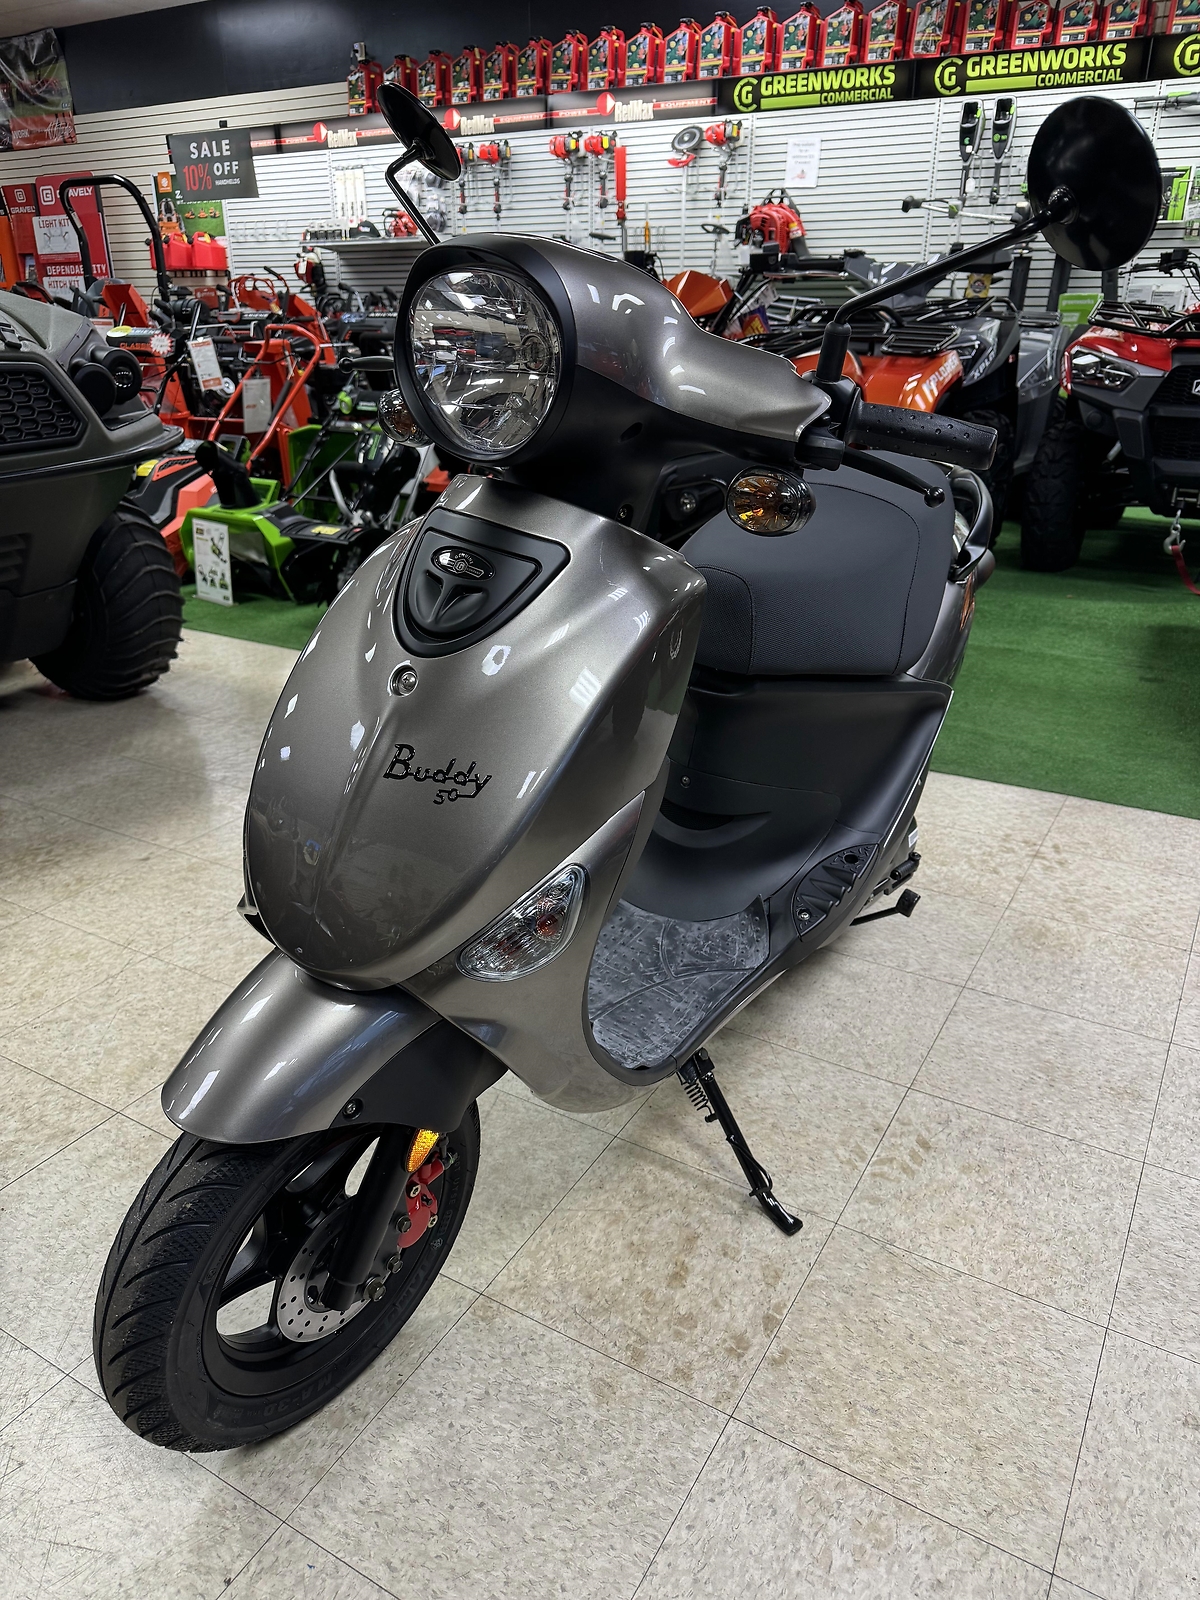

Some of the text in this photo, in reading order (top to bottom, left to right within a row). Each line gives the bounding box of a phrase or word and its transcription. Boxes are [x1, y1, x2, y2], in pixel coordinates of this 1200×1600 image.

[966, 43, 1127, 77] GREENWORKS
[760, 65, 896, 96] GREENWORKS
[1037, 68, 1123, 87] COMMERCIAL
[821, 87, 894, 105] COMMERCIAL
[558, 99, 711, 122] POWER RedMax EQUIPMENT
[461, 114, 495, 135] RedMax
[328, 128, 358, 148] RedMax
[190, 139, 231, 159] SALE
[183, 161, 239, 191] 10% OFF
[38, 217, 71, 229] LIGHT KIT
[48, 280, 67, 289] HITCH
[383, 744, 493, 798] Buddy
[433, 788, 459, 805] 50
